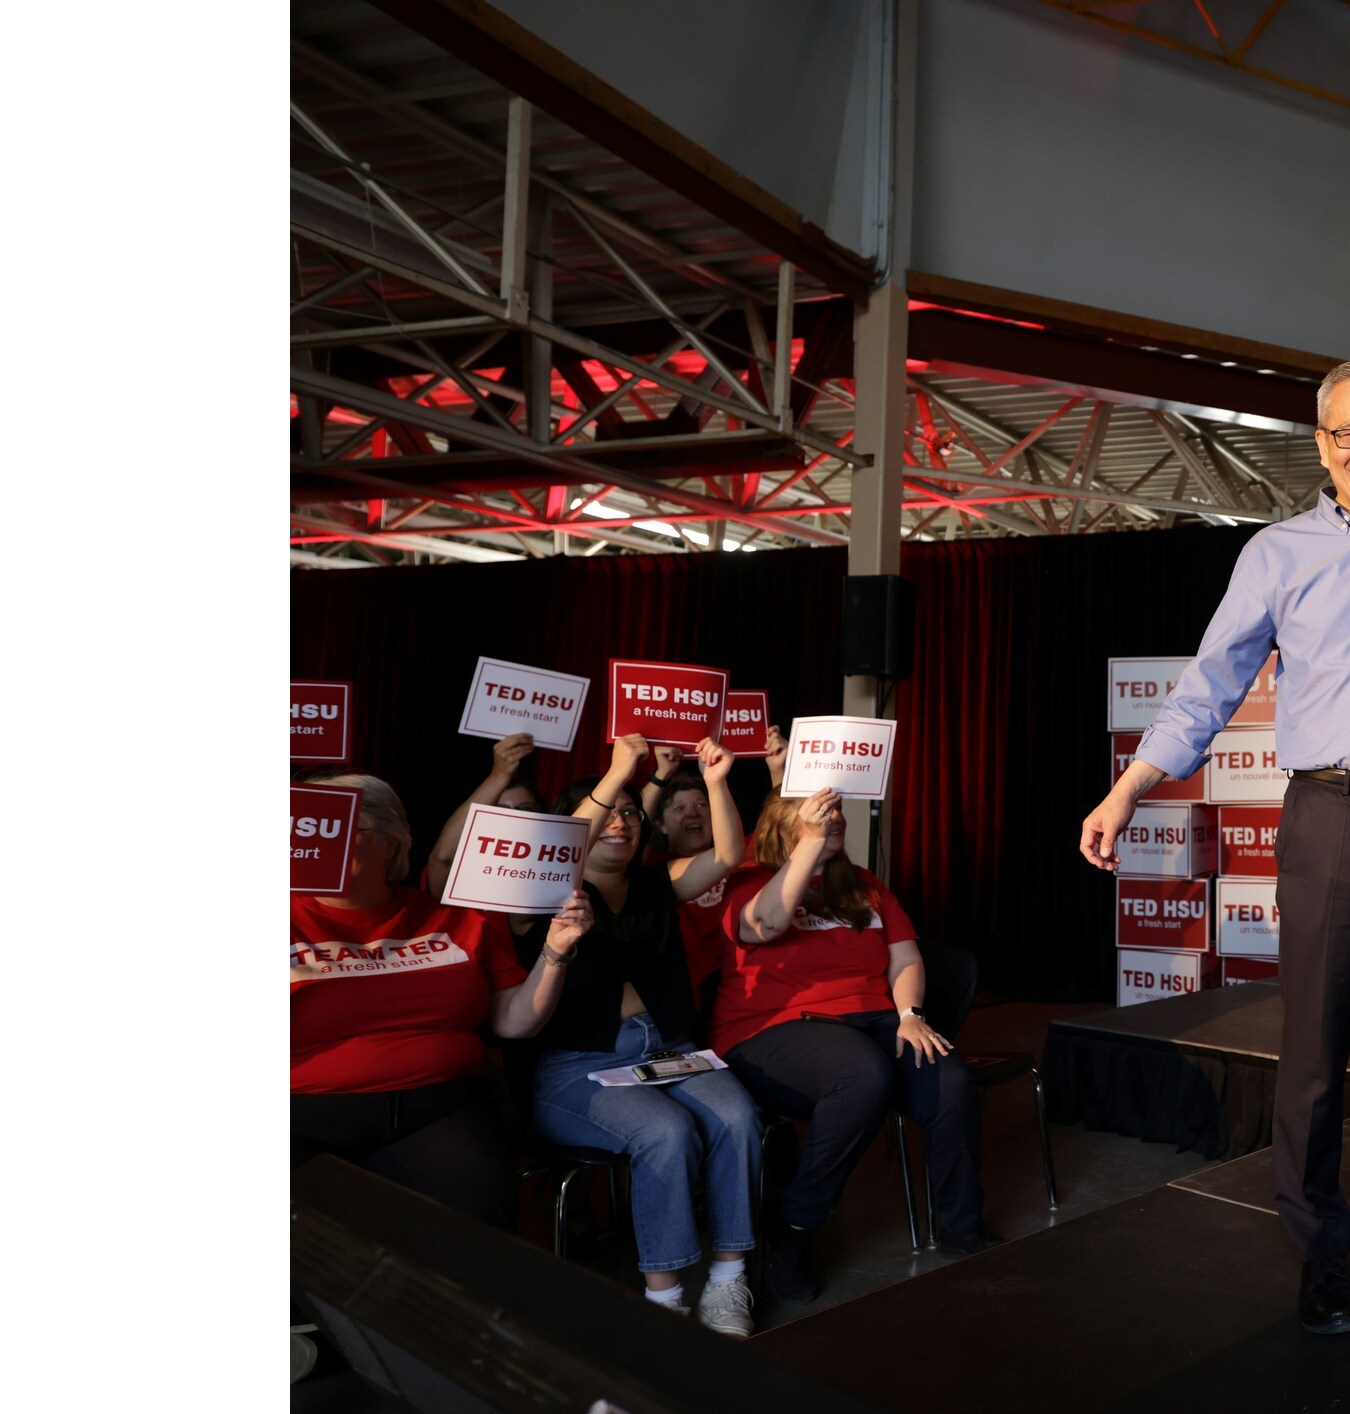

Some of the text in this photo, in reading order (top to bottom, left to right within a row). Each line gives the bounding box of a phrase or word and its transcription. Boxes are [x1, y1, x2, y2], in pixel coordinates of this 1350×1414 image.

[484, 682, 574, 711] TED HSU
[621, 683, 719, 708] TED HSU
[1116, 681, 1158, 698] TED
[489, 705, 559, 725] a fresh start
[633, 706, 708, 722] a fresh start
[725, 709, 762, 722] HSU
[730, 727, 754, 736] start
[799, 740, 884, 758] TED HSU
[804, 760, 871, 772] a fresh start
[1214, 752, 1254, 769] TED
[1242, 772, 1269, 780] nouvel
[1154, 827, 1186, 845] HSU
[1222, 827, 1256, 846] TED
[477, 836, 583, 864] TED HSU
[1244, 848, 1260, 856] fresh
[483, 865, 570, 883] a fresh start
[1121, 898, 1205, 919] TED HSU
[1224, 904, 1264, 922] TED
[1144, 919, 1163, 928] fresh
[1164, 920, 1182, 929] start
[290, 940, 450, 966] TEAM TED
[321, 956, 434, 974] a fresh start
[1123, 970, 1155, 989] TED
[1160, 973, 1195, 993] HSU
